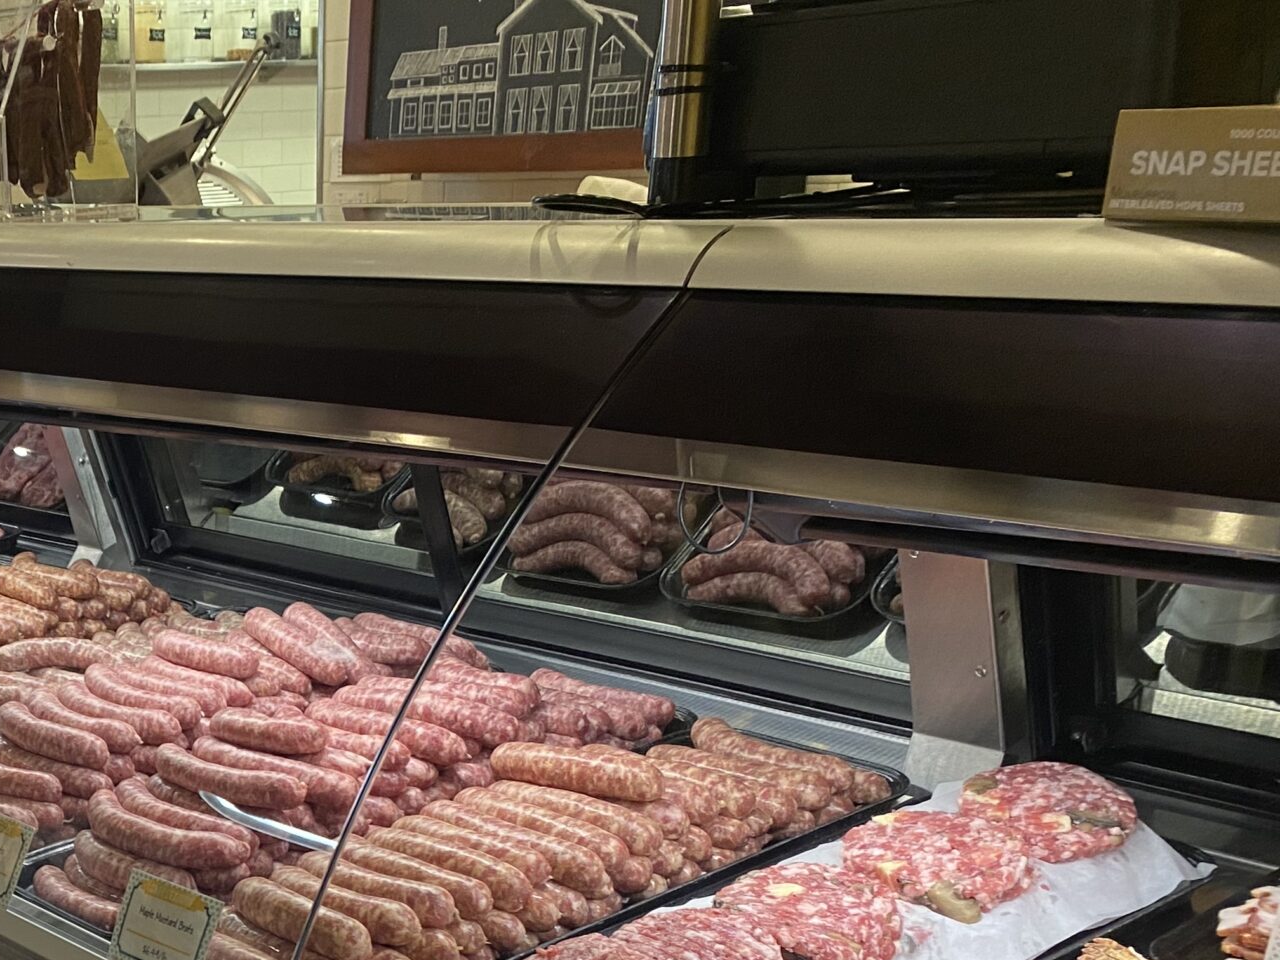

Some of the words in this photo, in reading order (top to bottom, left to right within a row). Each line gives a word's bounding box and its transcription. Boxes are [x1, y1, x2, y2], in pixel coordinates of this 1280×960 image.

[1230, 128, 1254, 139] 1000
[1130, 150, 1207, 176] SNAP
[1108, 198, 1173, 210] INTERLEAVED
[1205, 202, 1245, 213] SHEETS
[139, 904, 155, 920] Maple
[177, 920, 195, 936] Brats
